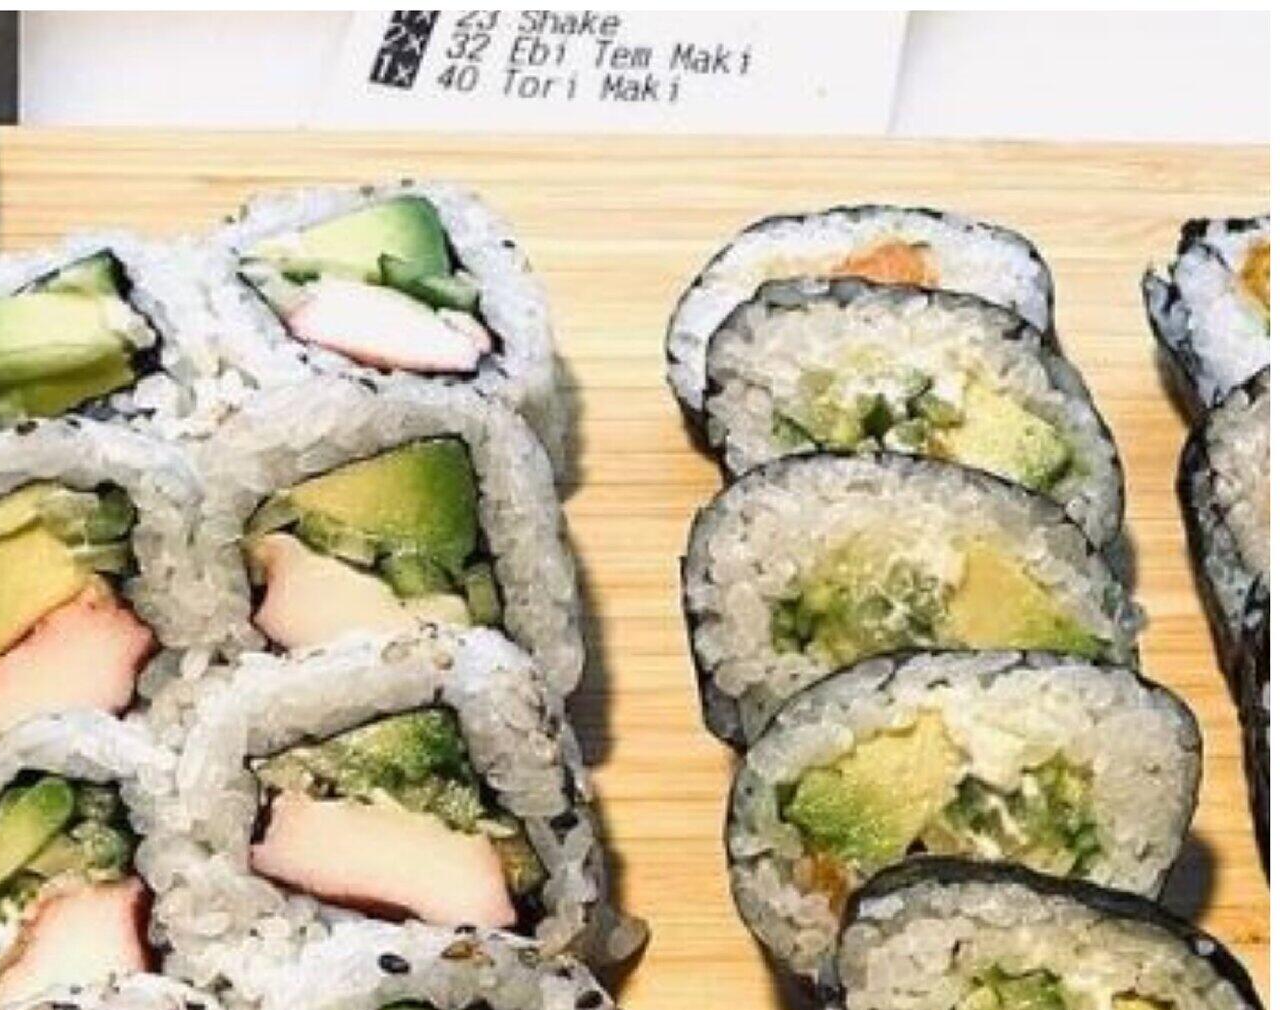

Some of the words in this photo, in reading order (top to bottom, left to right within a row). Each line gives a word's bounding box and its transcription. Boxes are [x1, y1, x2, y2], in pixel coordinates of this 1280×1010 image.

[518, 11, 620, 35] Shake
[446, 33, 491, 62] 32
[510, 36, 565, 66] Ebi
[596, 39, 653, 70] Tem
[670, 43, 751, 74] Maki
[437, 65, 479, 92] 40
[504, 68, 577, 99] Tori
[600, 73, 680, 102] Maki
